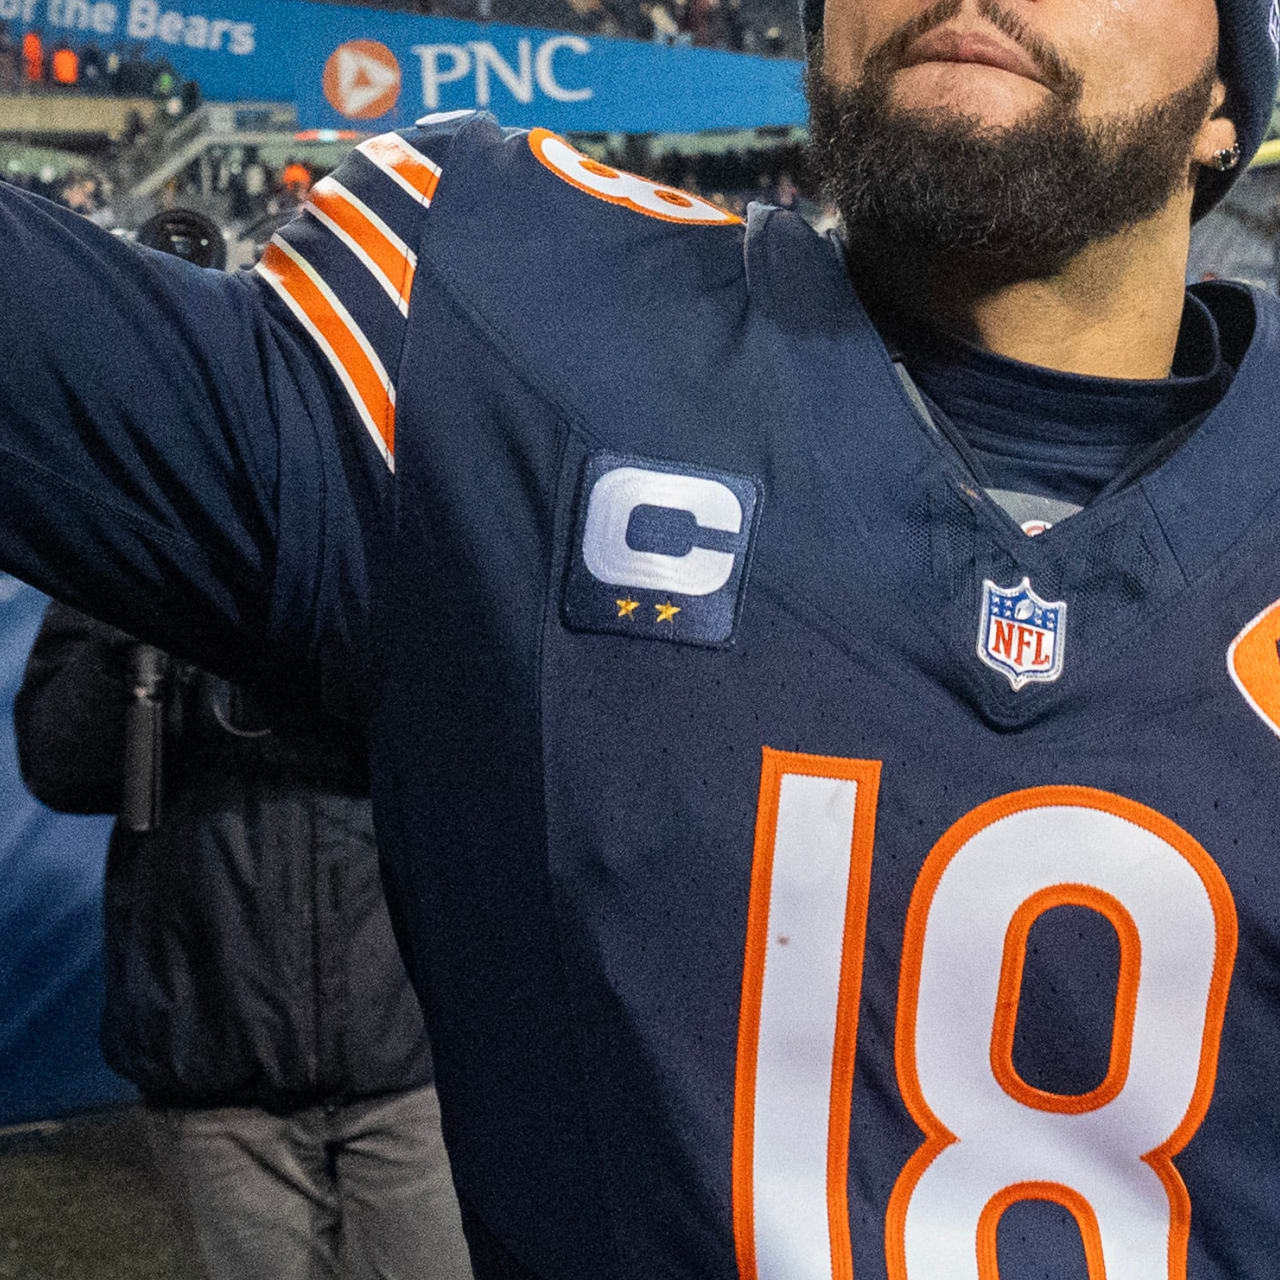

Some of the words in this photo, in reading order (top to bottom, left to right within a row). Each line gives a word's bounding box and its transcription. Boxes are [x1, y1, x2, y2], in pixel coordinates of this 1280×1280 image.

[412, 35, 593, 108] PNC
[582, 466, 742, 597] C
[991, 619, 1050, 666] NFL
